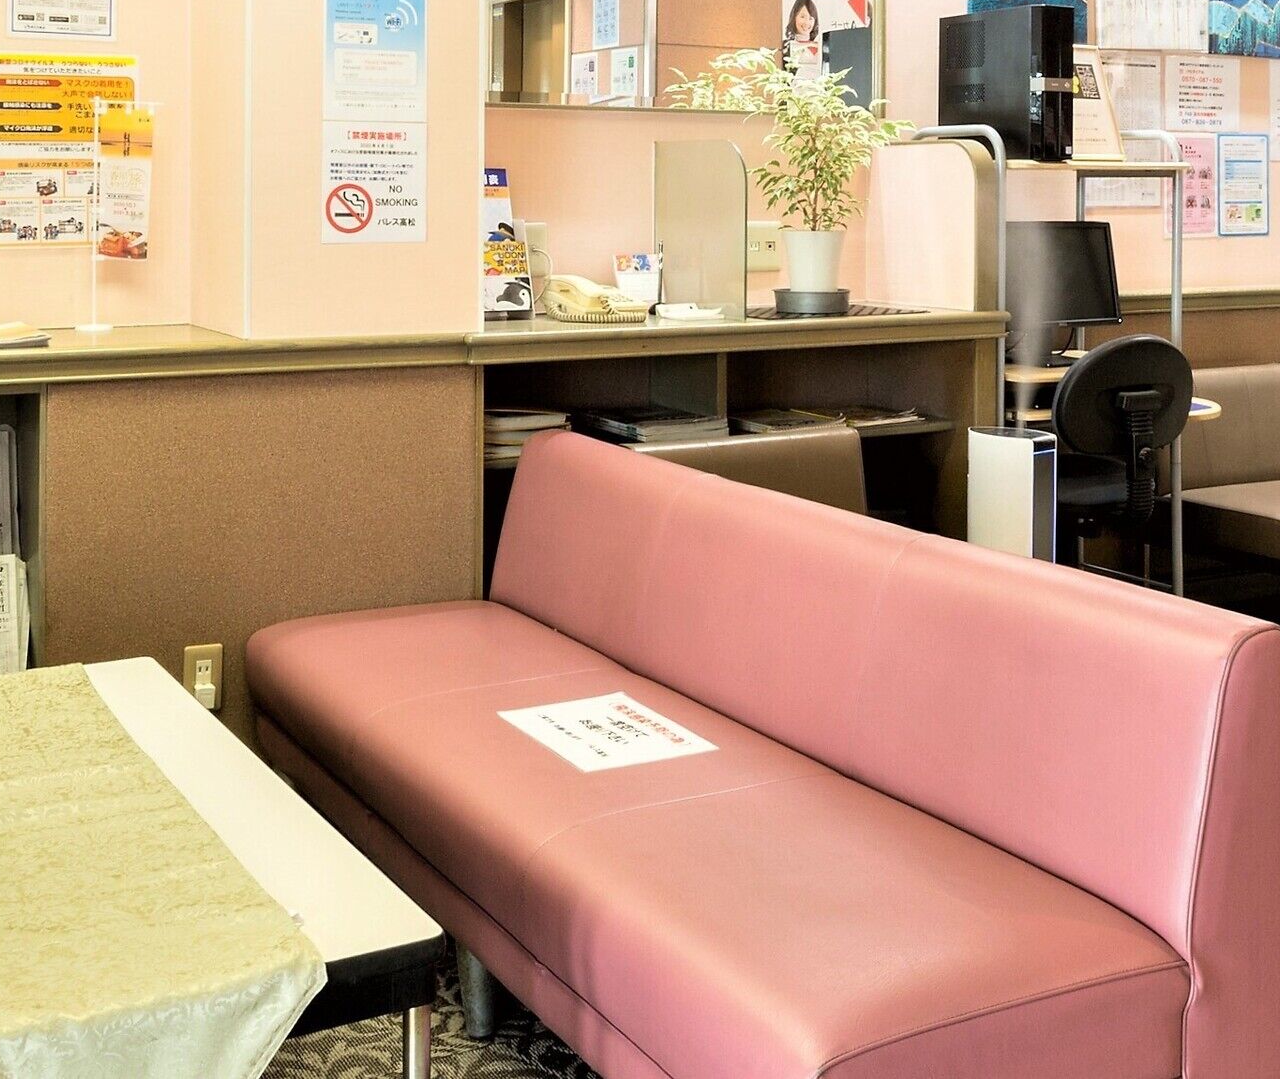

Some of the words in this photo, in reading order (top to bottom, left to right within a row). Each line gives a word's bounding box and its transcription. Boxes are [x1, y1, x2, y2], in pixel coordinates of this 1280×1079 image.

[388, 185, 403, 193] NO
[375, 198, 418, 207] SMOKING
[377, 217, 416, 227] パレス高松
[489, 244, 525, 252] SANUKI
[498, 251, 524, 259] UDON
[504, 266, 526, 274] MAP
